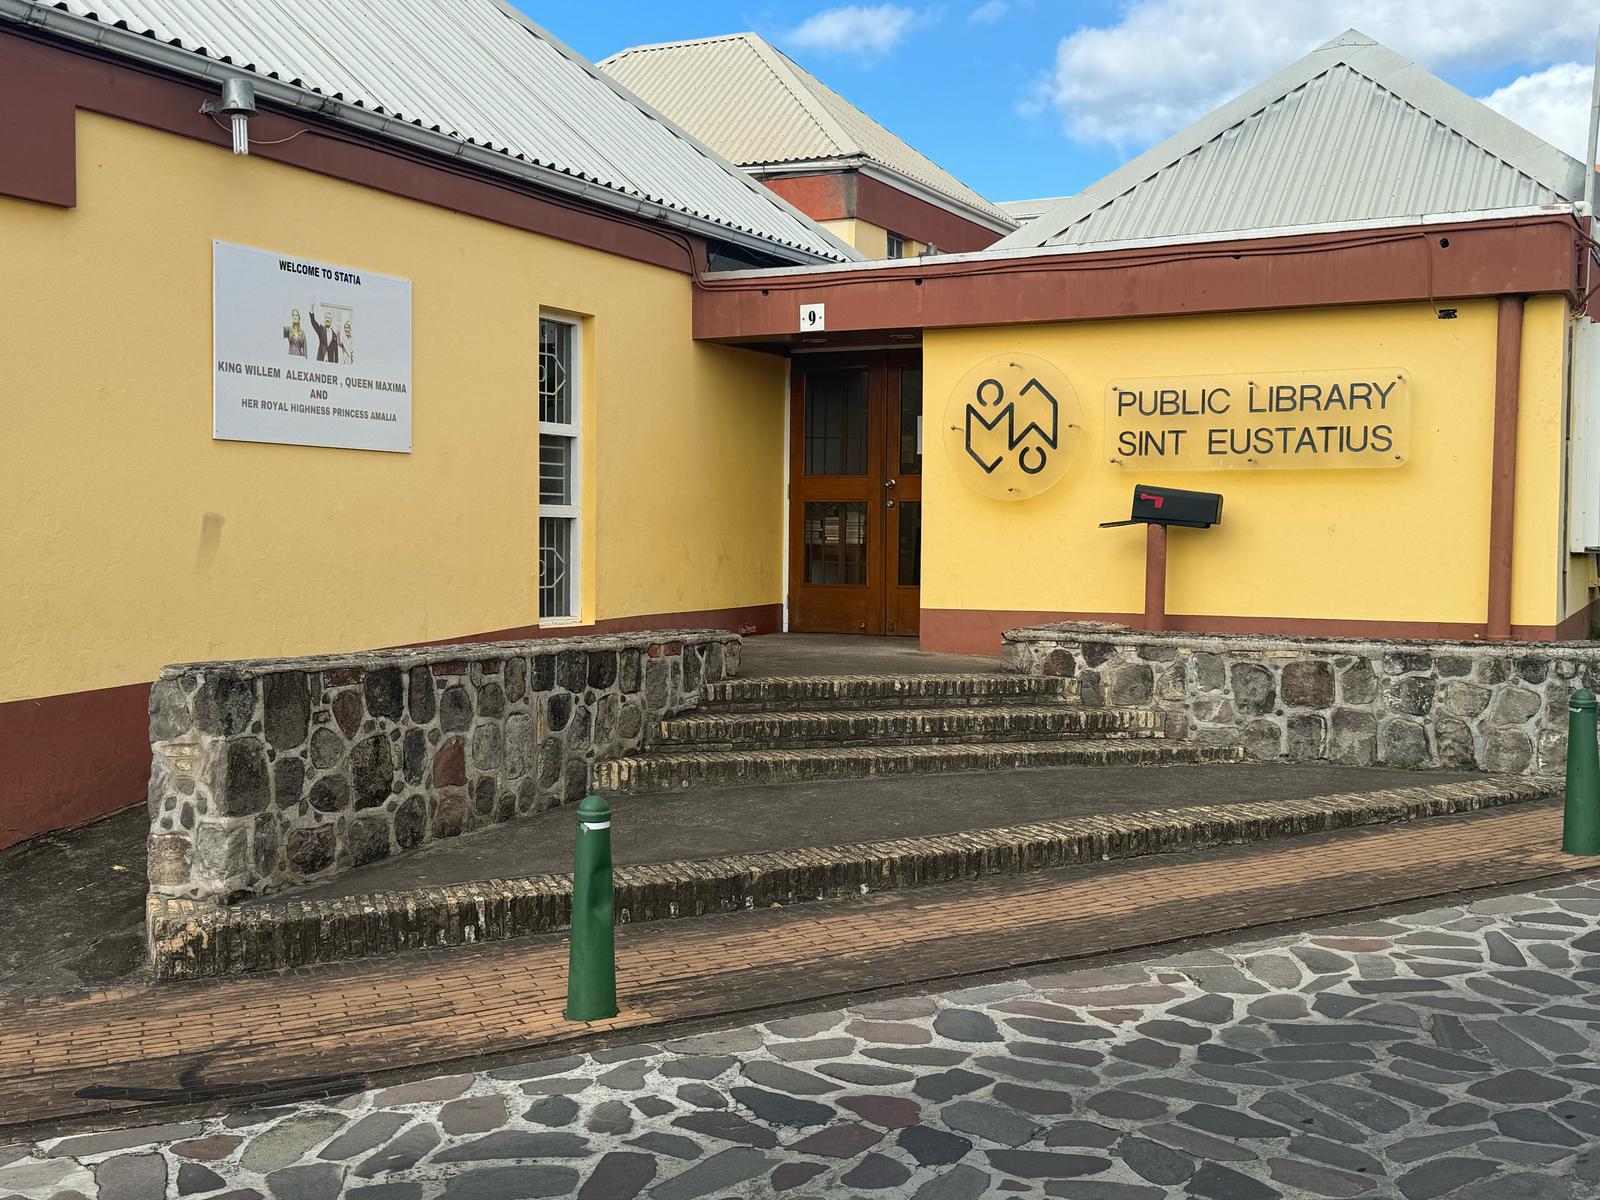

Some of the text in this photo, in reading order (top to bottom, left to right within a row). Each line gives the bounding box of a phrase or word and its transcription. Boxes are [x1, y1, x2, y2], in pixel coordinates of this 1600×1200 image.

[279, 259, 361, 285] WELCOME TO STATIA
[808, 310, 816, 326] 9
[218, 361, 242, 374] KING
[245, 364, 281, 378] WILLEM
[345, 377, 373, 389] QUEEN
[375, 380, 407, 393] MAXIMA
[310, 389, 328, 400] AND
[1118, 382, 1396, 416] PUBLIC LIBRARY
[241, 398, 397, 422] HER ROYAL HIGHNESS PRINCESS AMALIA
[1117, 425, 1393, 456] SINT EUSTATIUS
